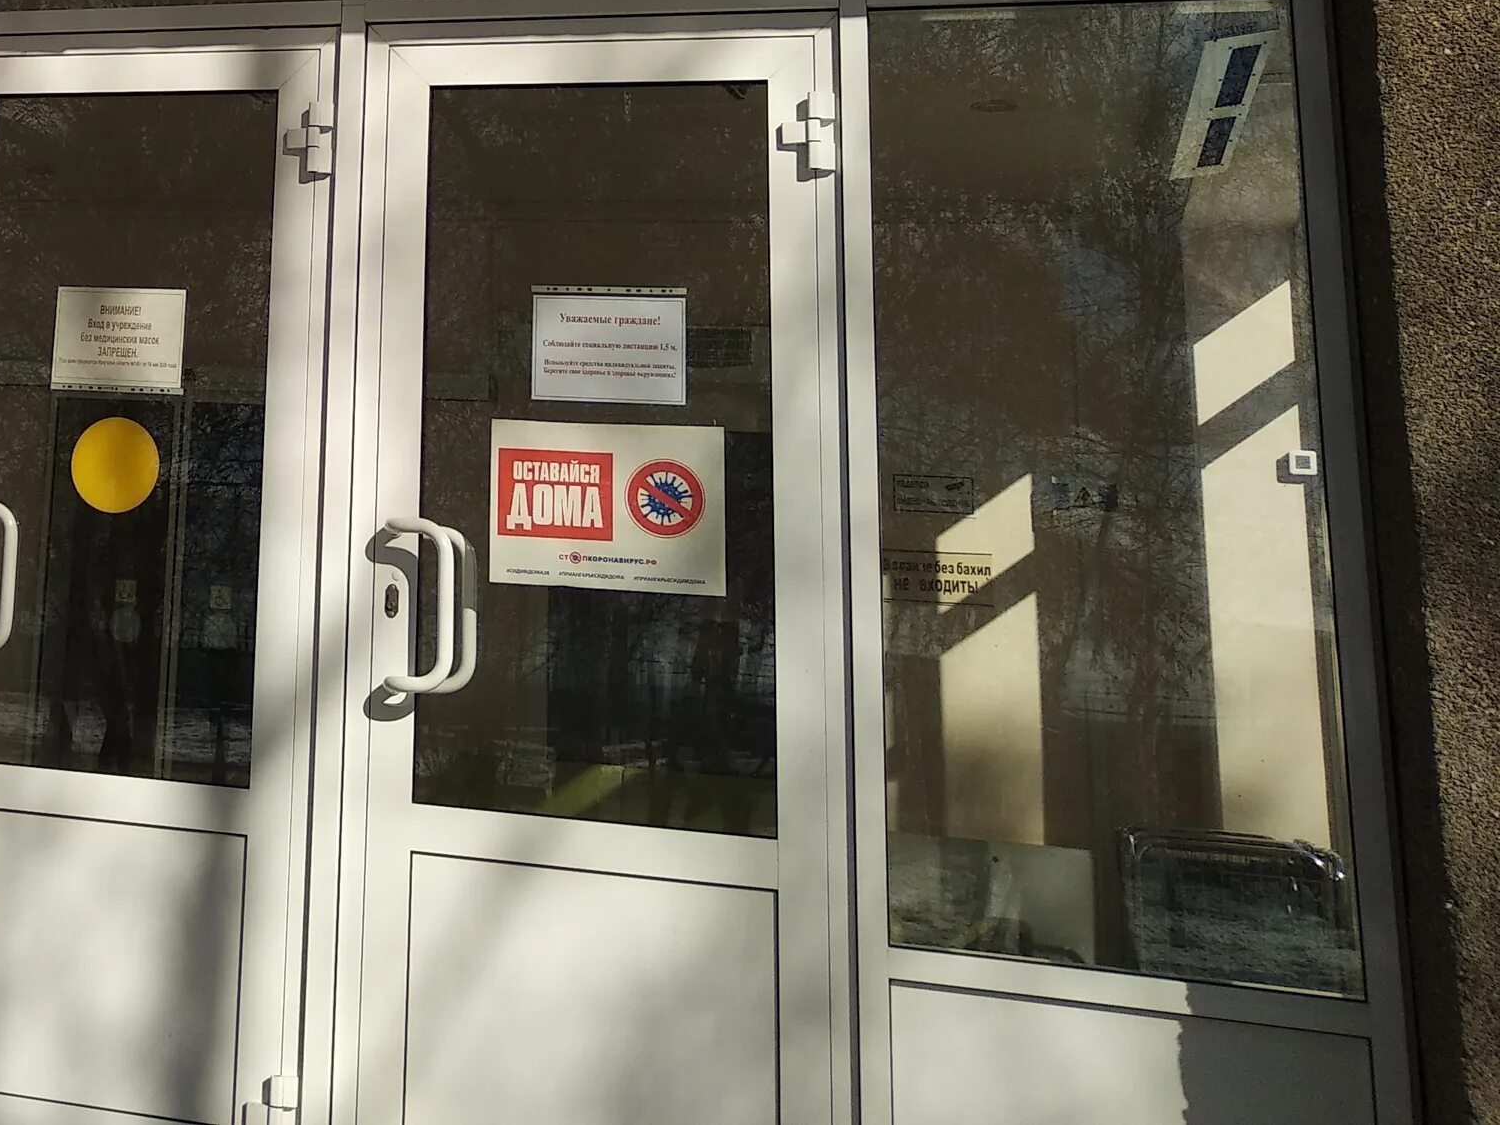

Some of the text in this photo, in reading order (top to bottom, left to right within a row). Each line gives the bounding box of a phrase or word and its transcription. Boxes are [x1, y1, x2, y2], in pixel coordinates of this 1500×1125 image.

[100, 305, 141, 316] ВНИМАНИЕ!
[87, 318, 105, 330] Вход
[111, 322, 152, 332] учреждение
[559, 313, 661, 327] Уважаемые граждане!
[80, 332, 160, 345] без медицинских масок
[542, 339, 581, 348] Соблюдайте
[582, 341, 622, 351] социальную
[623, 343, 658, 351] дистанцию
[513, 459, 600, 484] ОСТАВАЙСЯ
[506, 482, 603, 531] ДОМА
[934, 560, 955, 574] без
[956, 562, 991, 576] бахил
[894, 578, 909, 591] НЕ
